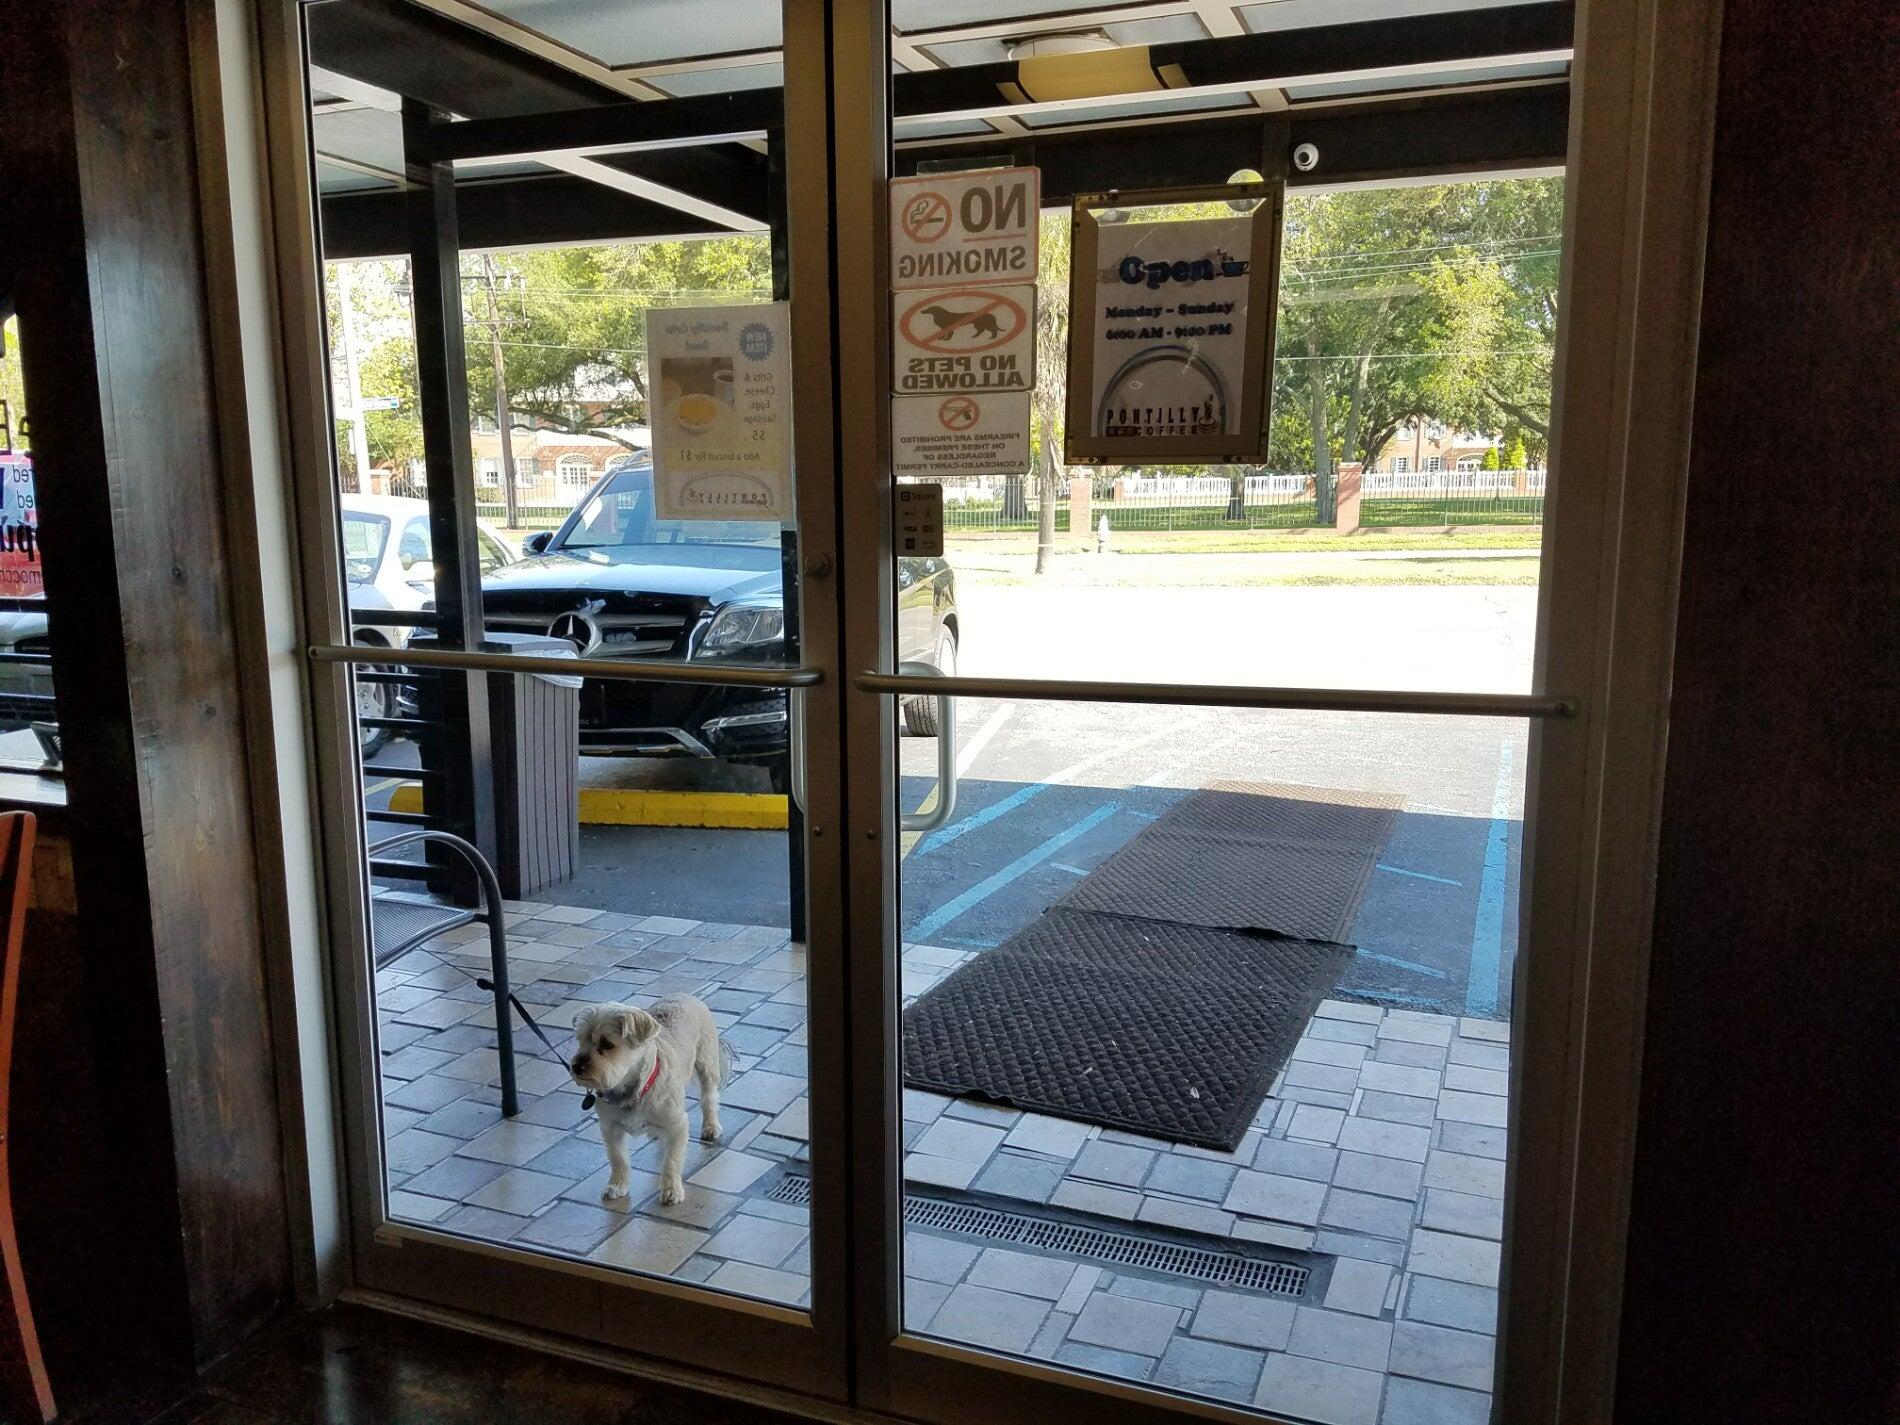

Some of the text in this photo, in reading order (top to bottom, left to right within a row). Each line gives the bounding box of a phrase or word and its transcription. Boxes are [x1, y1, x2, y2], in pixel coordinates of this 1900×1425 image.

[1119, 256, 1215, 289] Open
[1105, 305, 1162, 318] Monday
[1178, 302, 1234, 315] Sunday
[1139, 327, 1164, 339] AM
[1208, 323, 1232, 335] PM
[1107, 407, 1200, 424] PONTILLY
[1136, 425, 1198, 436] COFFEE
